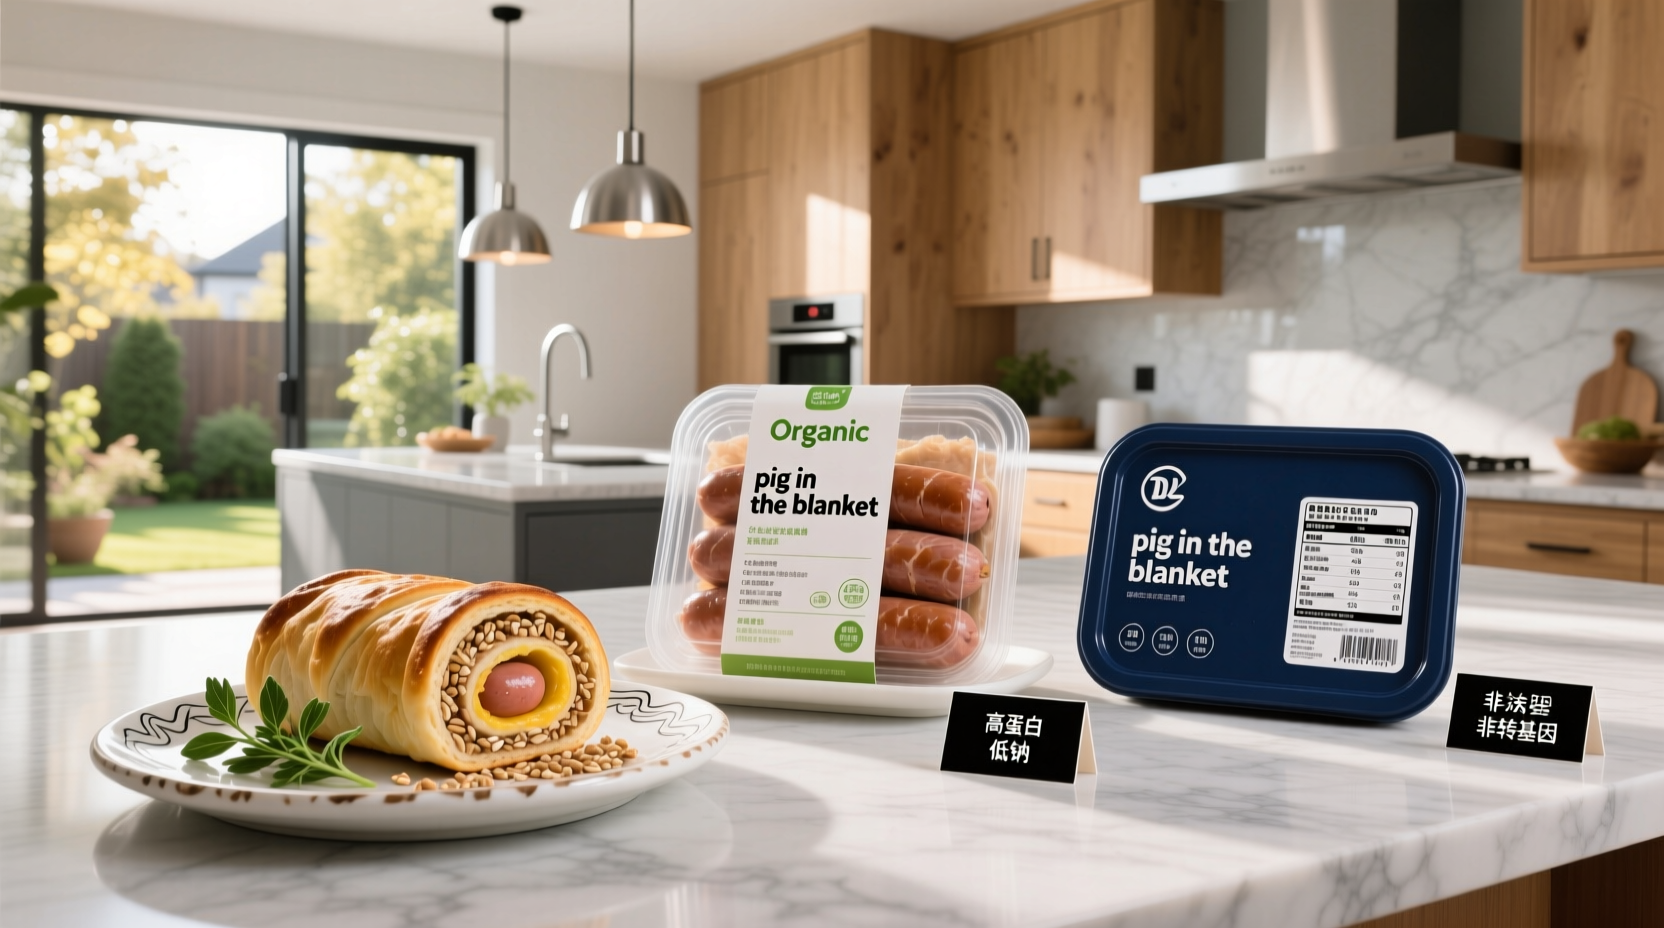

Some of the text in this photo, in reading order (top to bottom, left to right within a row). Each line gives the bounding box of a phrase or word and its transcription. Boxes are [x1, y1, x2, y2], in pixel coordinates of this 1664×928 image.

[770, 418, 870, 449] Organic
[754, 466, 817, 494] pig in
[750, 493, 879, 517] the blanket
[1131, 527, 1252, 560] pig in the
[1128, 558, 1230, 589] blanket
[985, 711, 1043, 737] 高蛋白
[1476, 714, 1558, 744] 非转基因
[989, 738, 1030, 764] 低钠
